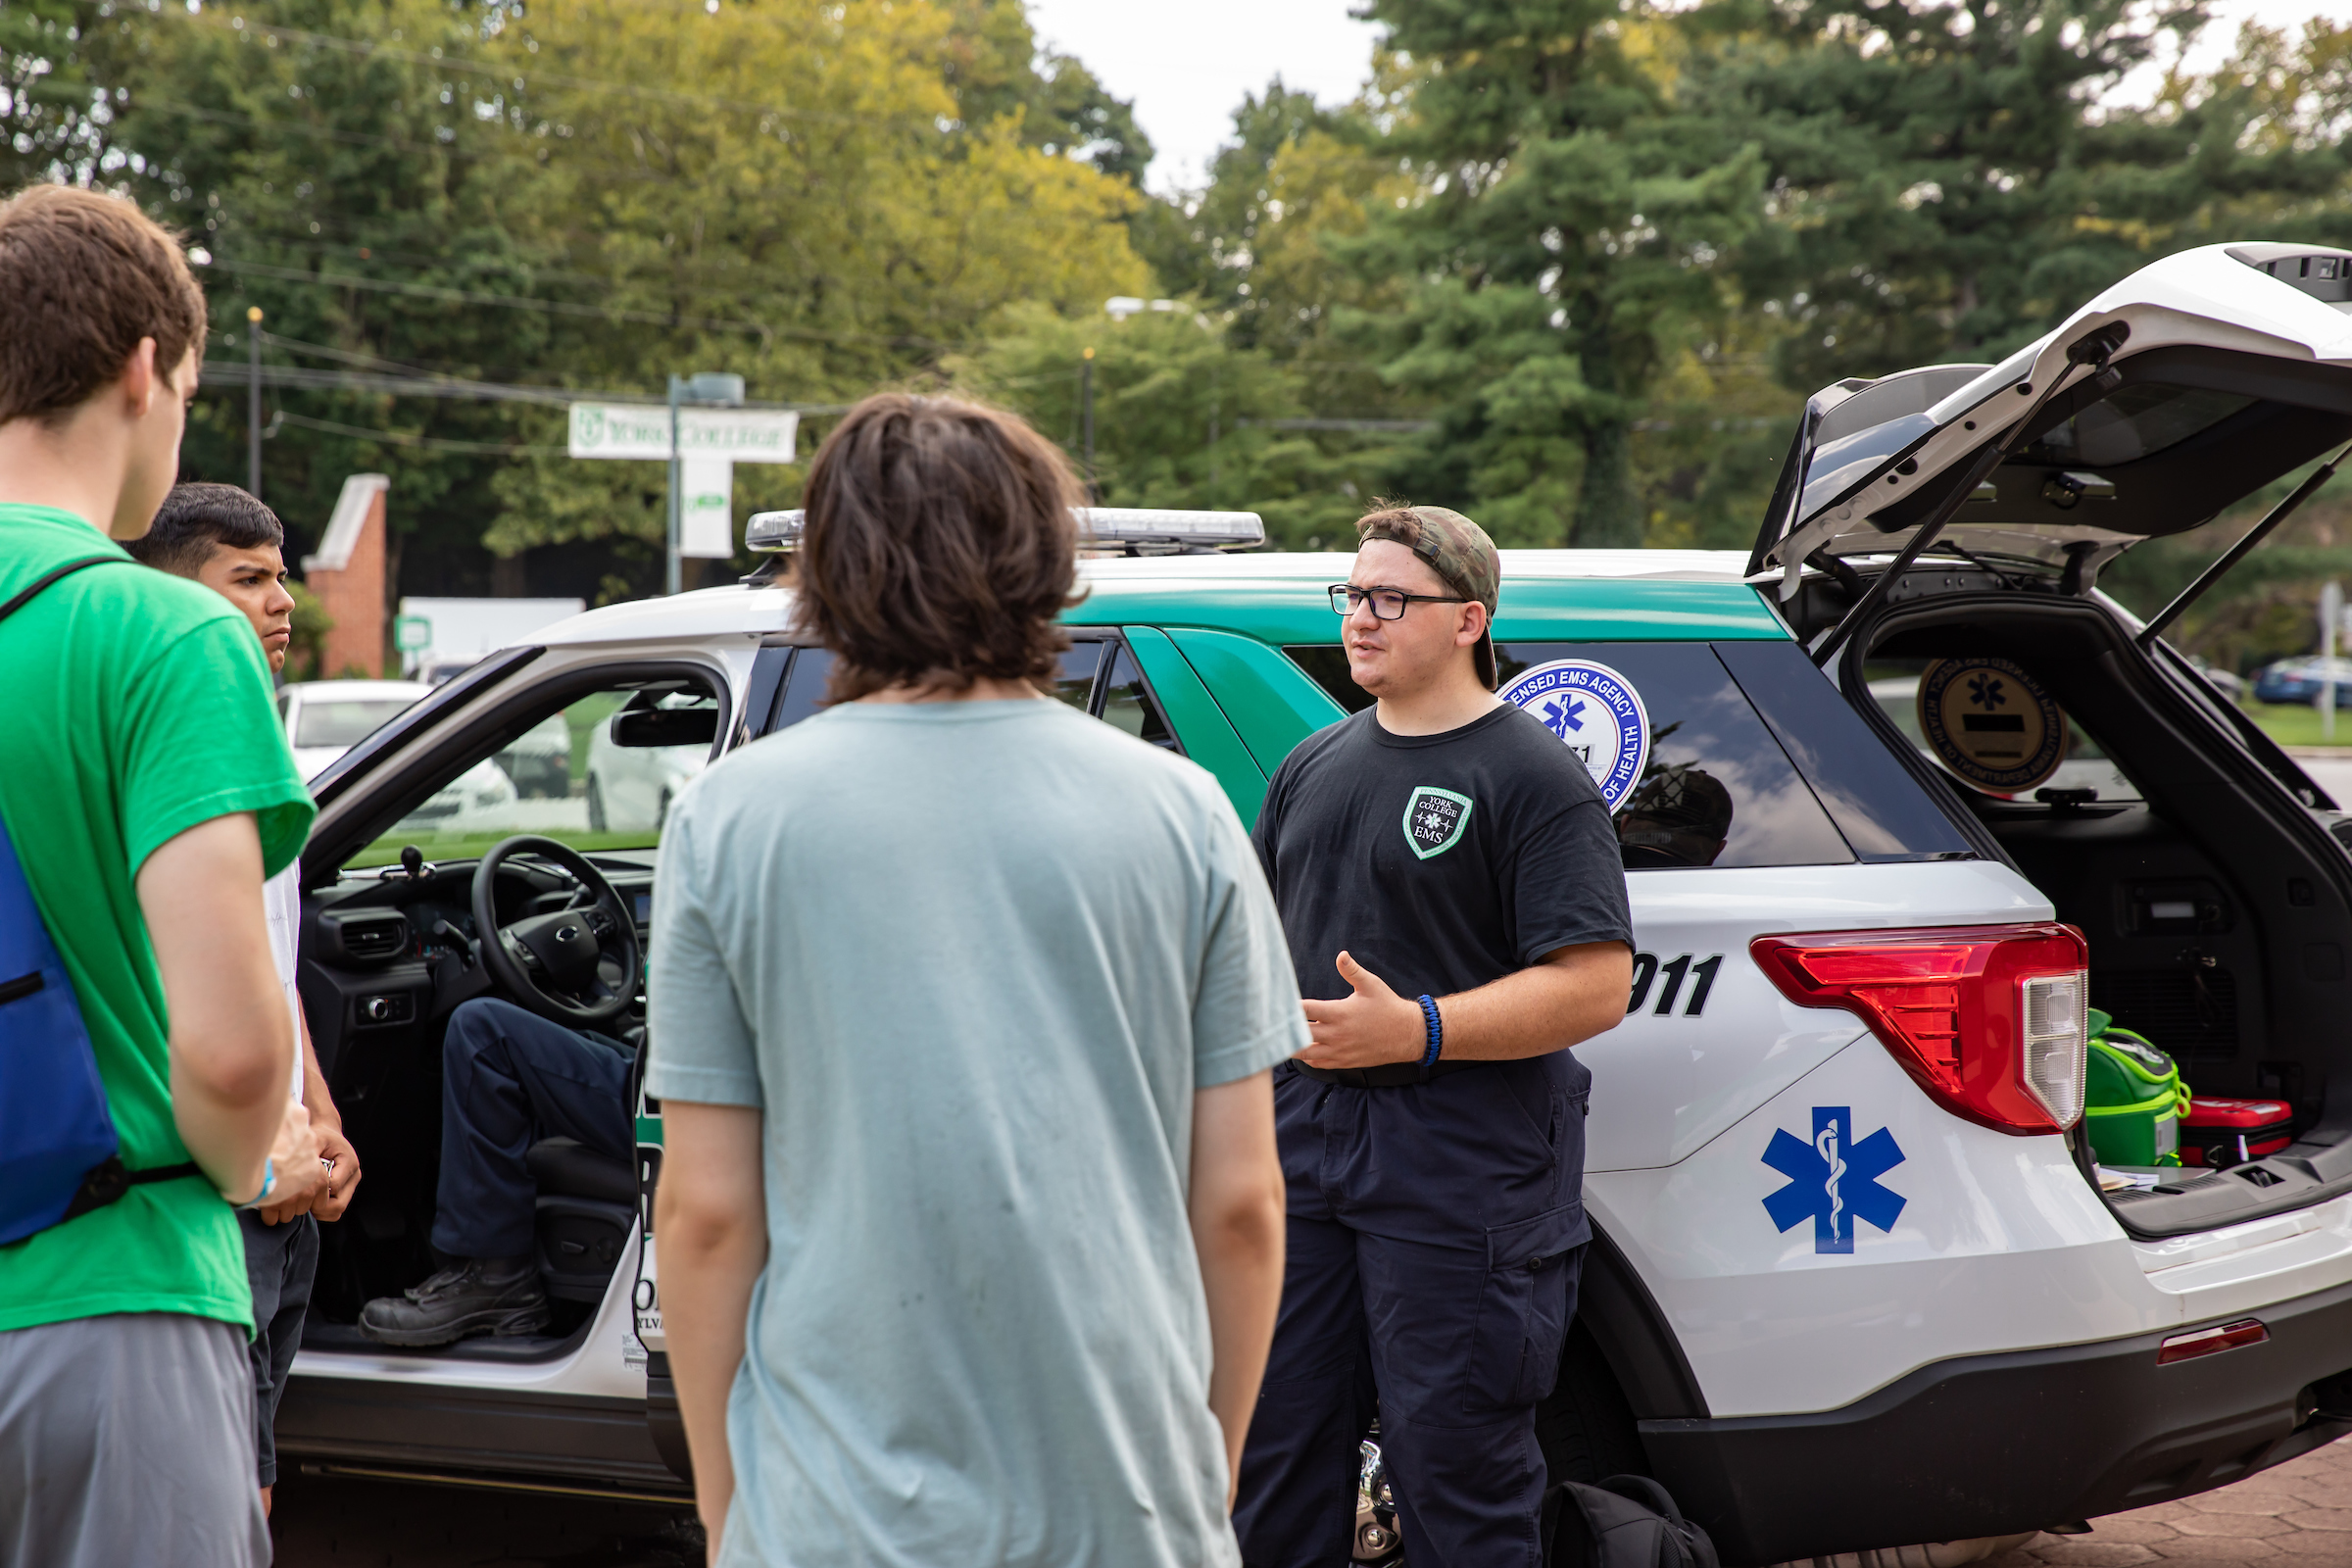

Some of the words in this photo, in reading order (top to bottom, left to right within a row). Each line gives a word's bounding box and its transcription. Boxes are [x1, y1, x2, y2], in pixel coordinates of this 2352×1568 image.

[1507, 674, 1555, 706] ENSED
[1559, 671, 1590, 685] EMS
[1589, 676, 1634, 717] AGENCY
[1603, 780, 1620, 800] OF
[1616, 725, 1638, 780] HEALTH
[1420, 788, 1467, 804] PENNSYLVANIA
[1430, 796, 1453, 808] YORK
[1419, 802, 1457, 817] COLLEGE
[1414, 826, 1444, 843] EMS
[1626, 953, 1724, 1015] 911
